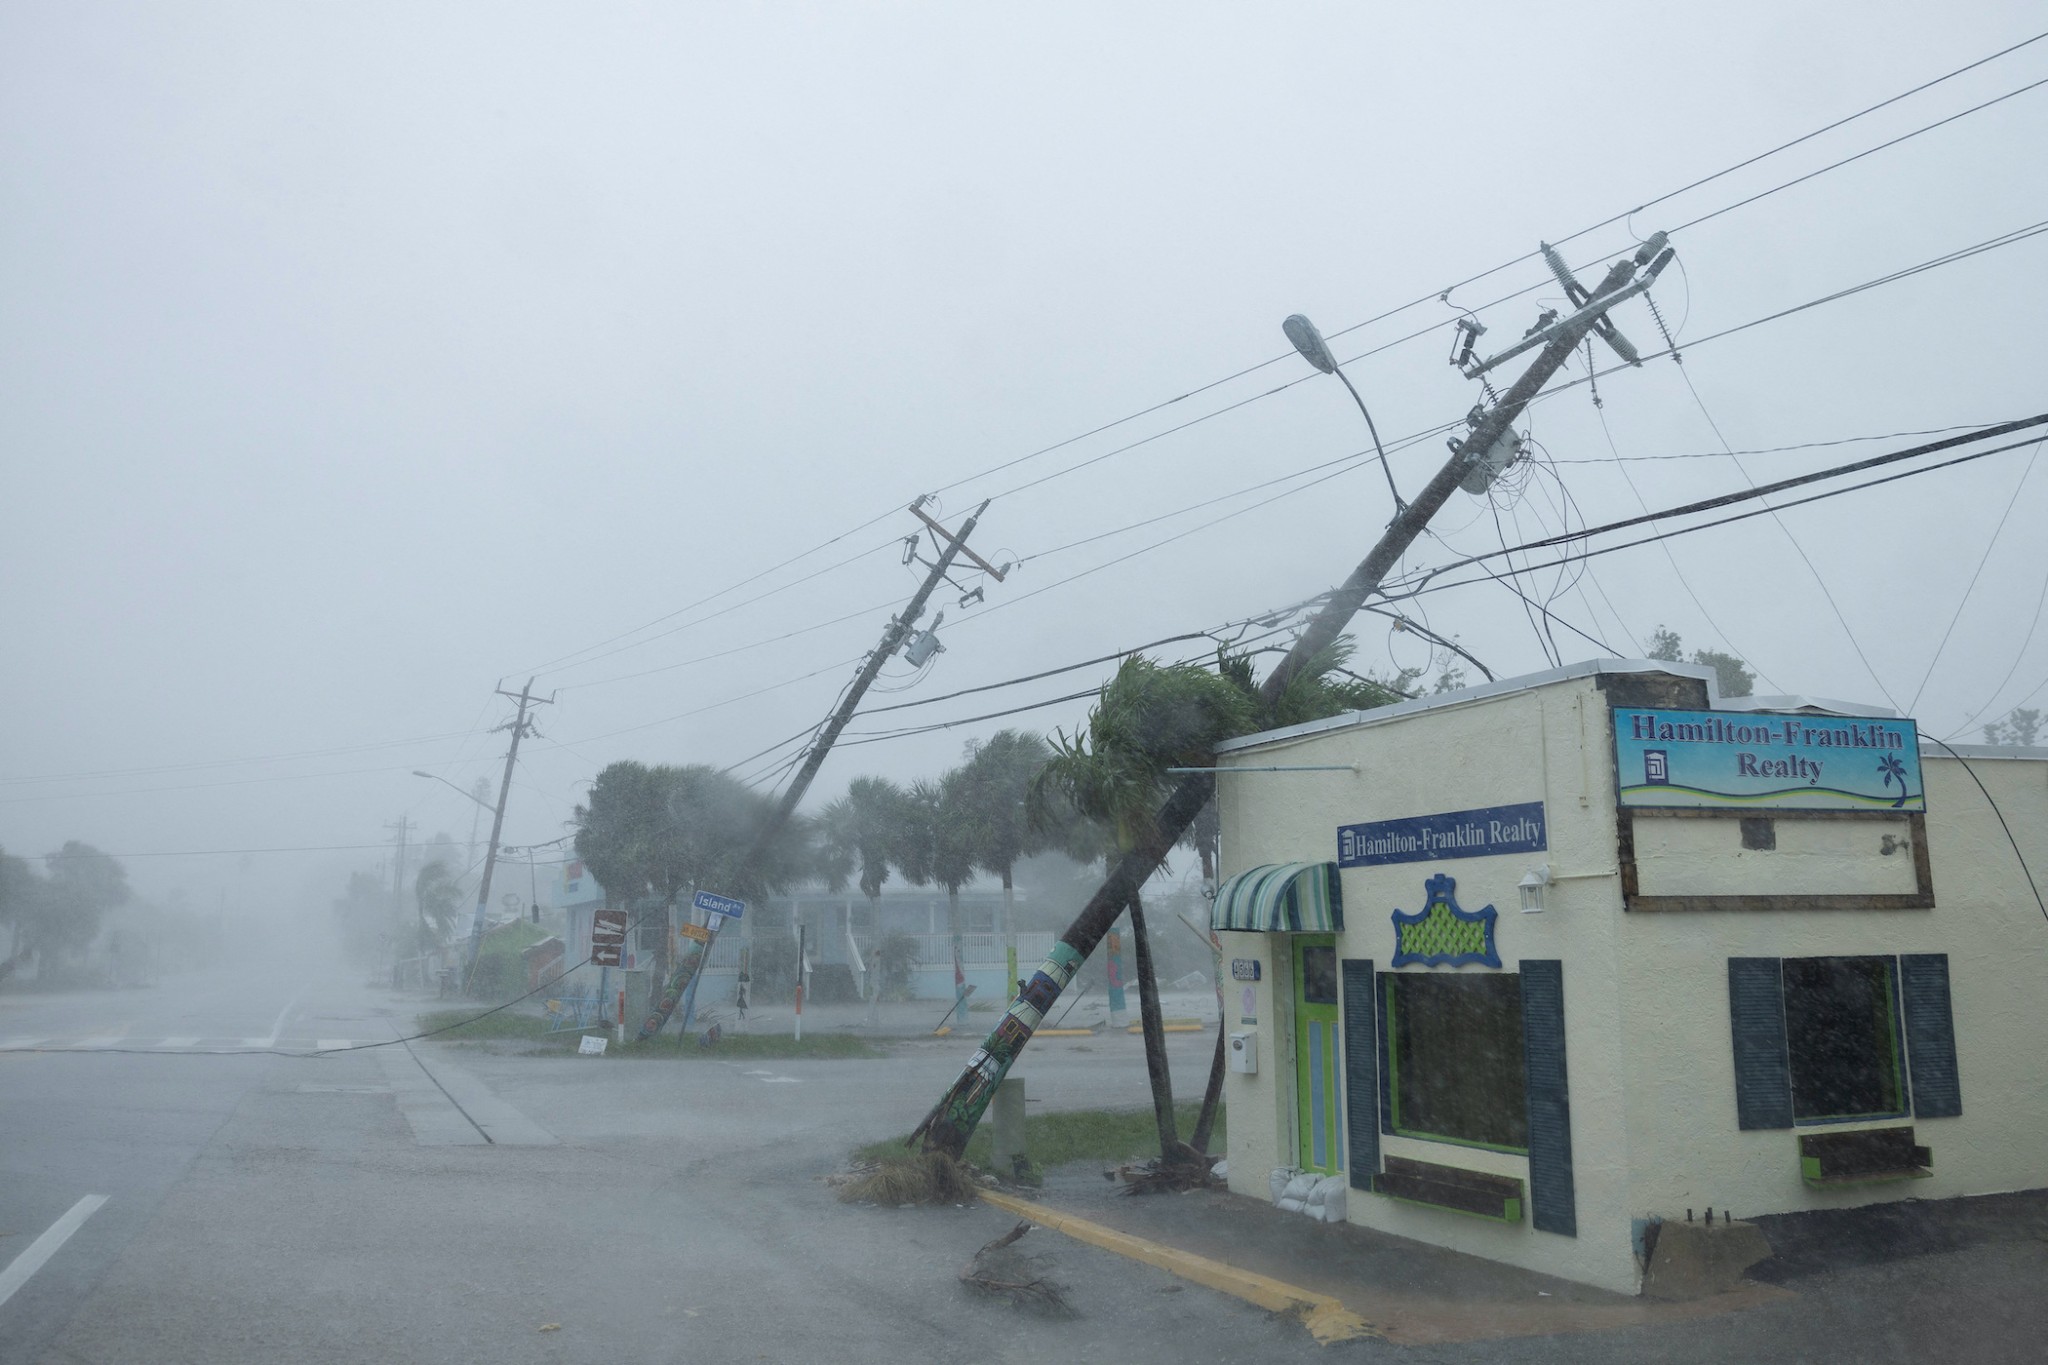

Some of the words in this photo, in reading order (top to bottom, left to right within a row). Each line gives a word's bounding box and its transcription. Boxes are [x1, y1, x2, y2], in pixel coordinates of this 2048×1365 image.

[1630, 714, 1904, 750] Hamilton-Franklin
[1736, 752, 1825, 785] Realty
[1356, 823, 1485, 857] Hamilton-Franklin
[1489, 817, 1542, 847] Realty
[699, 895, 732, 912] Island
